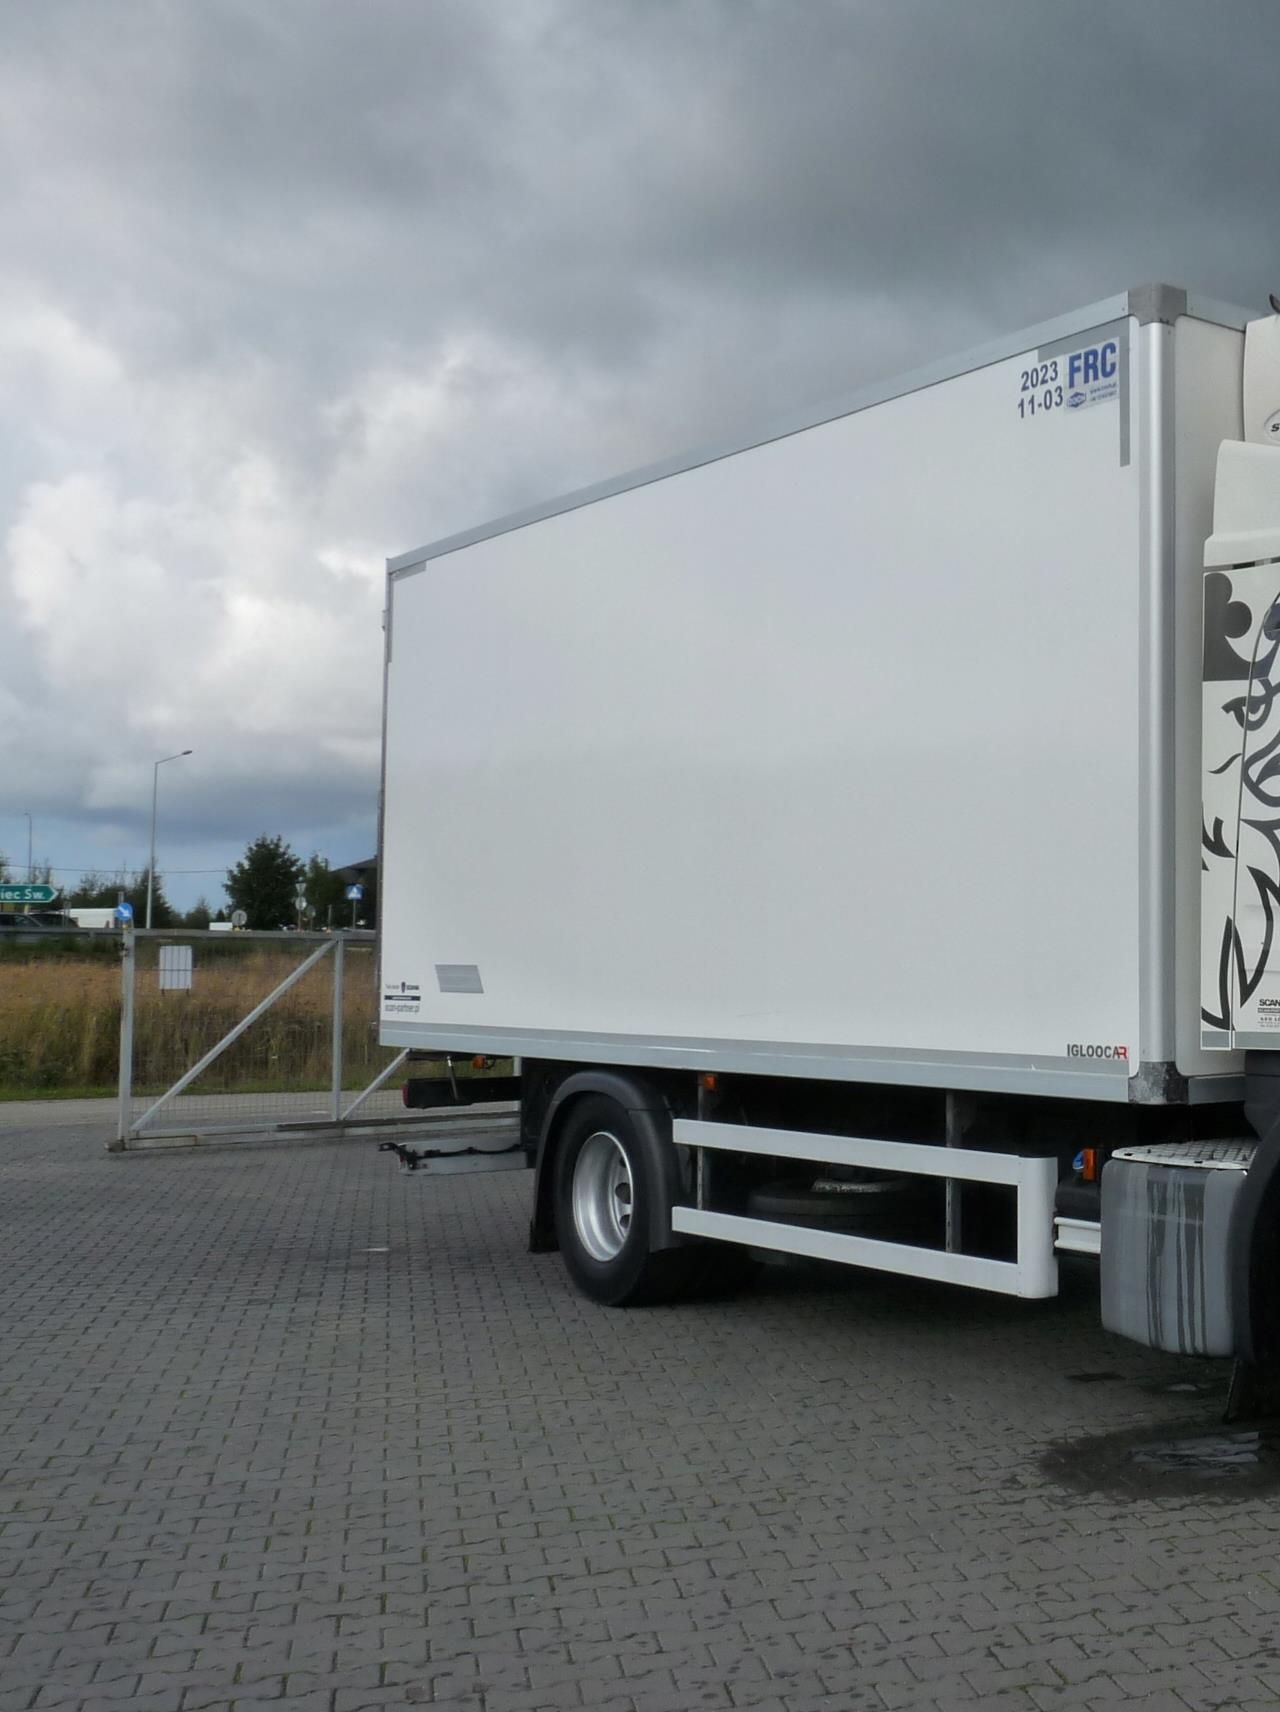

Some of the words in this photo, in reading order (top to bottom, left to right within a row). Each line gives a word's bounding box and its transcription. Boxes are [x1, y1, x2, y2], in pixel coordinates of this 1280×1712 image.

[1020, 360, 1059, 393] 2023
[1068, 342, 1117, 389] FRC
[1017, 385, 1064, 419] 11-03
[1066, 1043, 1128, 1060] IGLOOCAR
